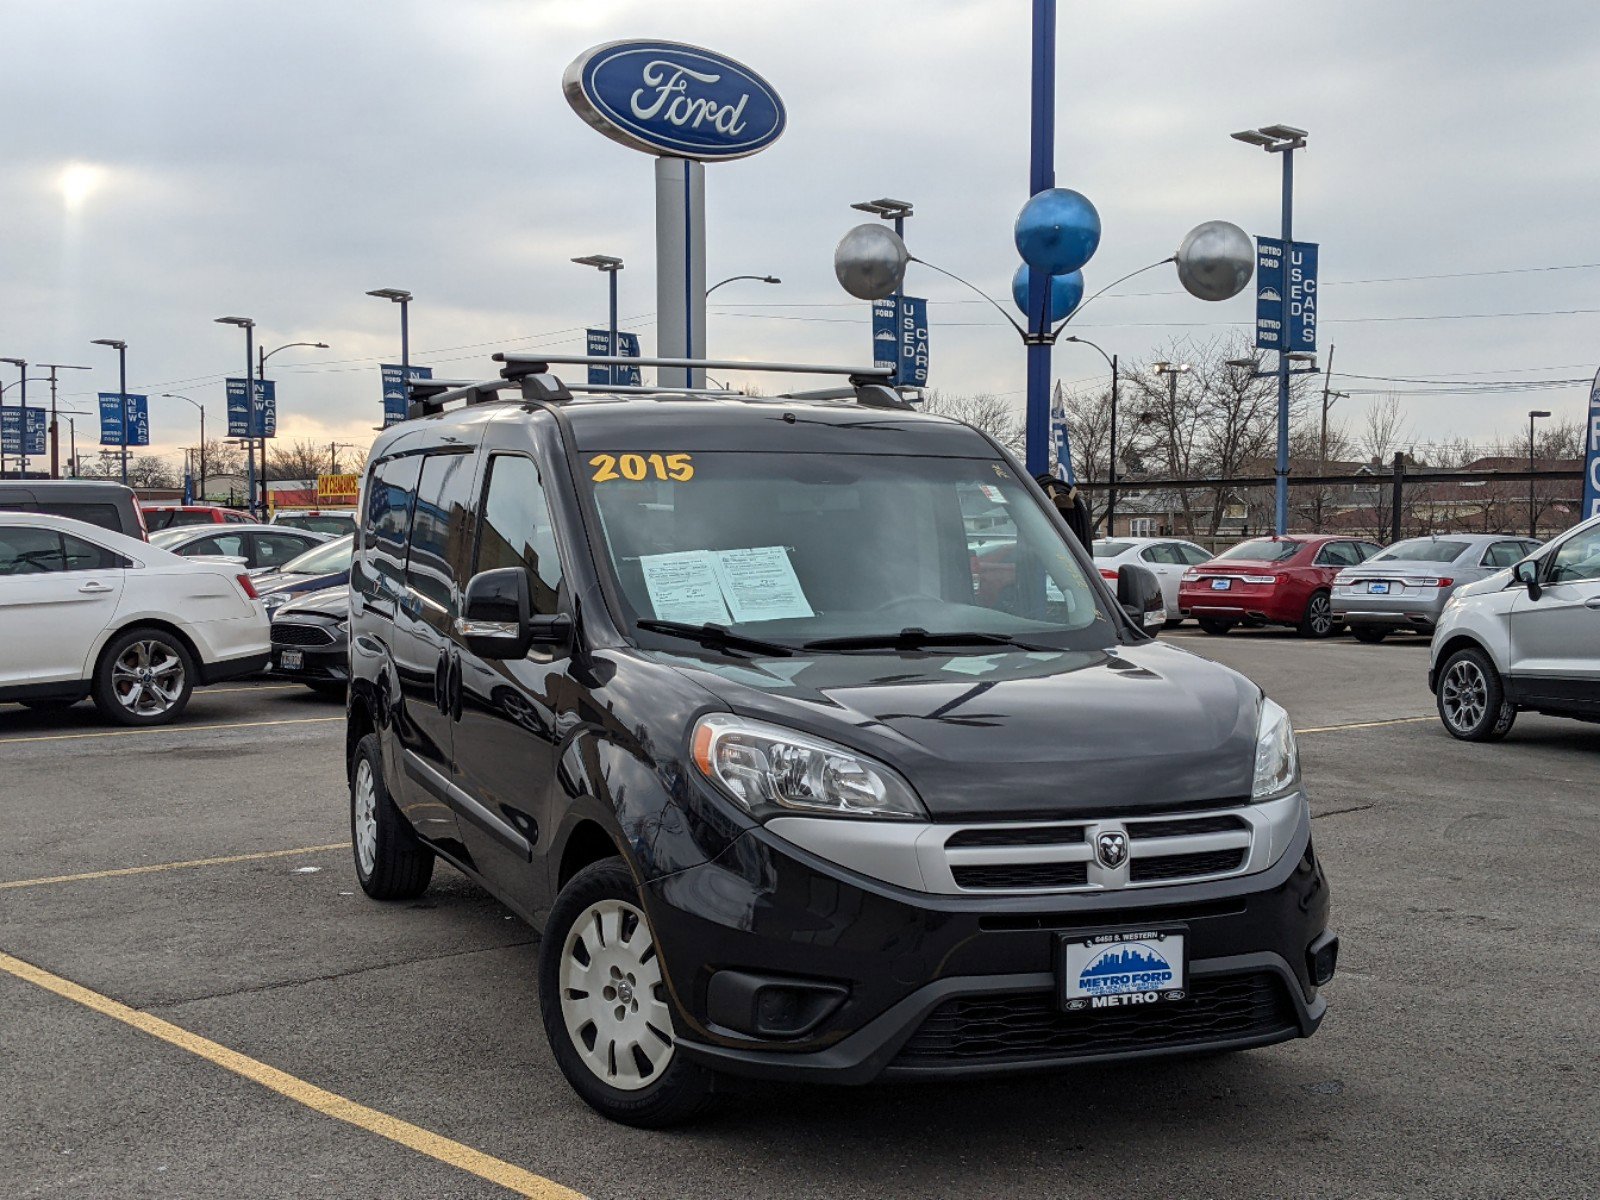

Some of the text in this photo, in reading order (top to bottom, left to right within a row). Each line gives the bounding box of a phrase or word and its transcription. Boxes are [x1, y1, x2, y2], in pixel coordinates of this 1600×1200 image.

[630, 60, 749, 136] Ford
[1258, 245, 1282, 256] METRO
[1260, 258, 1279, 269] FORD
[1291, 251, 1302, 316] USED
[873, 299, 896, 308] METRO
[875, 309, 894, 318] FORD
[1302, 280, 1316, 343] CARS
[903, 303, 915, 358] USED
[1258, 319, 1281, 330] METRO
[588, 334, 609, 344] METRO
[1259, 332, 1278, 341] FORD
[914, 328, 928, 381] CARS
[254, 384, 265, 411] NEW
[127, 398, 138, 422] NEW
[264, 399, 276, 434] CARS
[26, 411, 36, 433] NEW
[137, 411, 148, 443] CARS
[35, 423, 46, 451] CARS
[589, 454, 694, 482] 2015
[1122, 931, 1158, 941] WESTERN
[1079, 974, 1130, 988] METRO
[1131, 971, 1173, 983] FORD
[1092, 991, 1158, 1009] METRO
